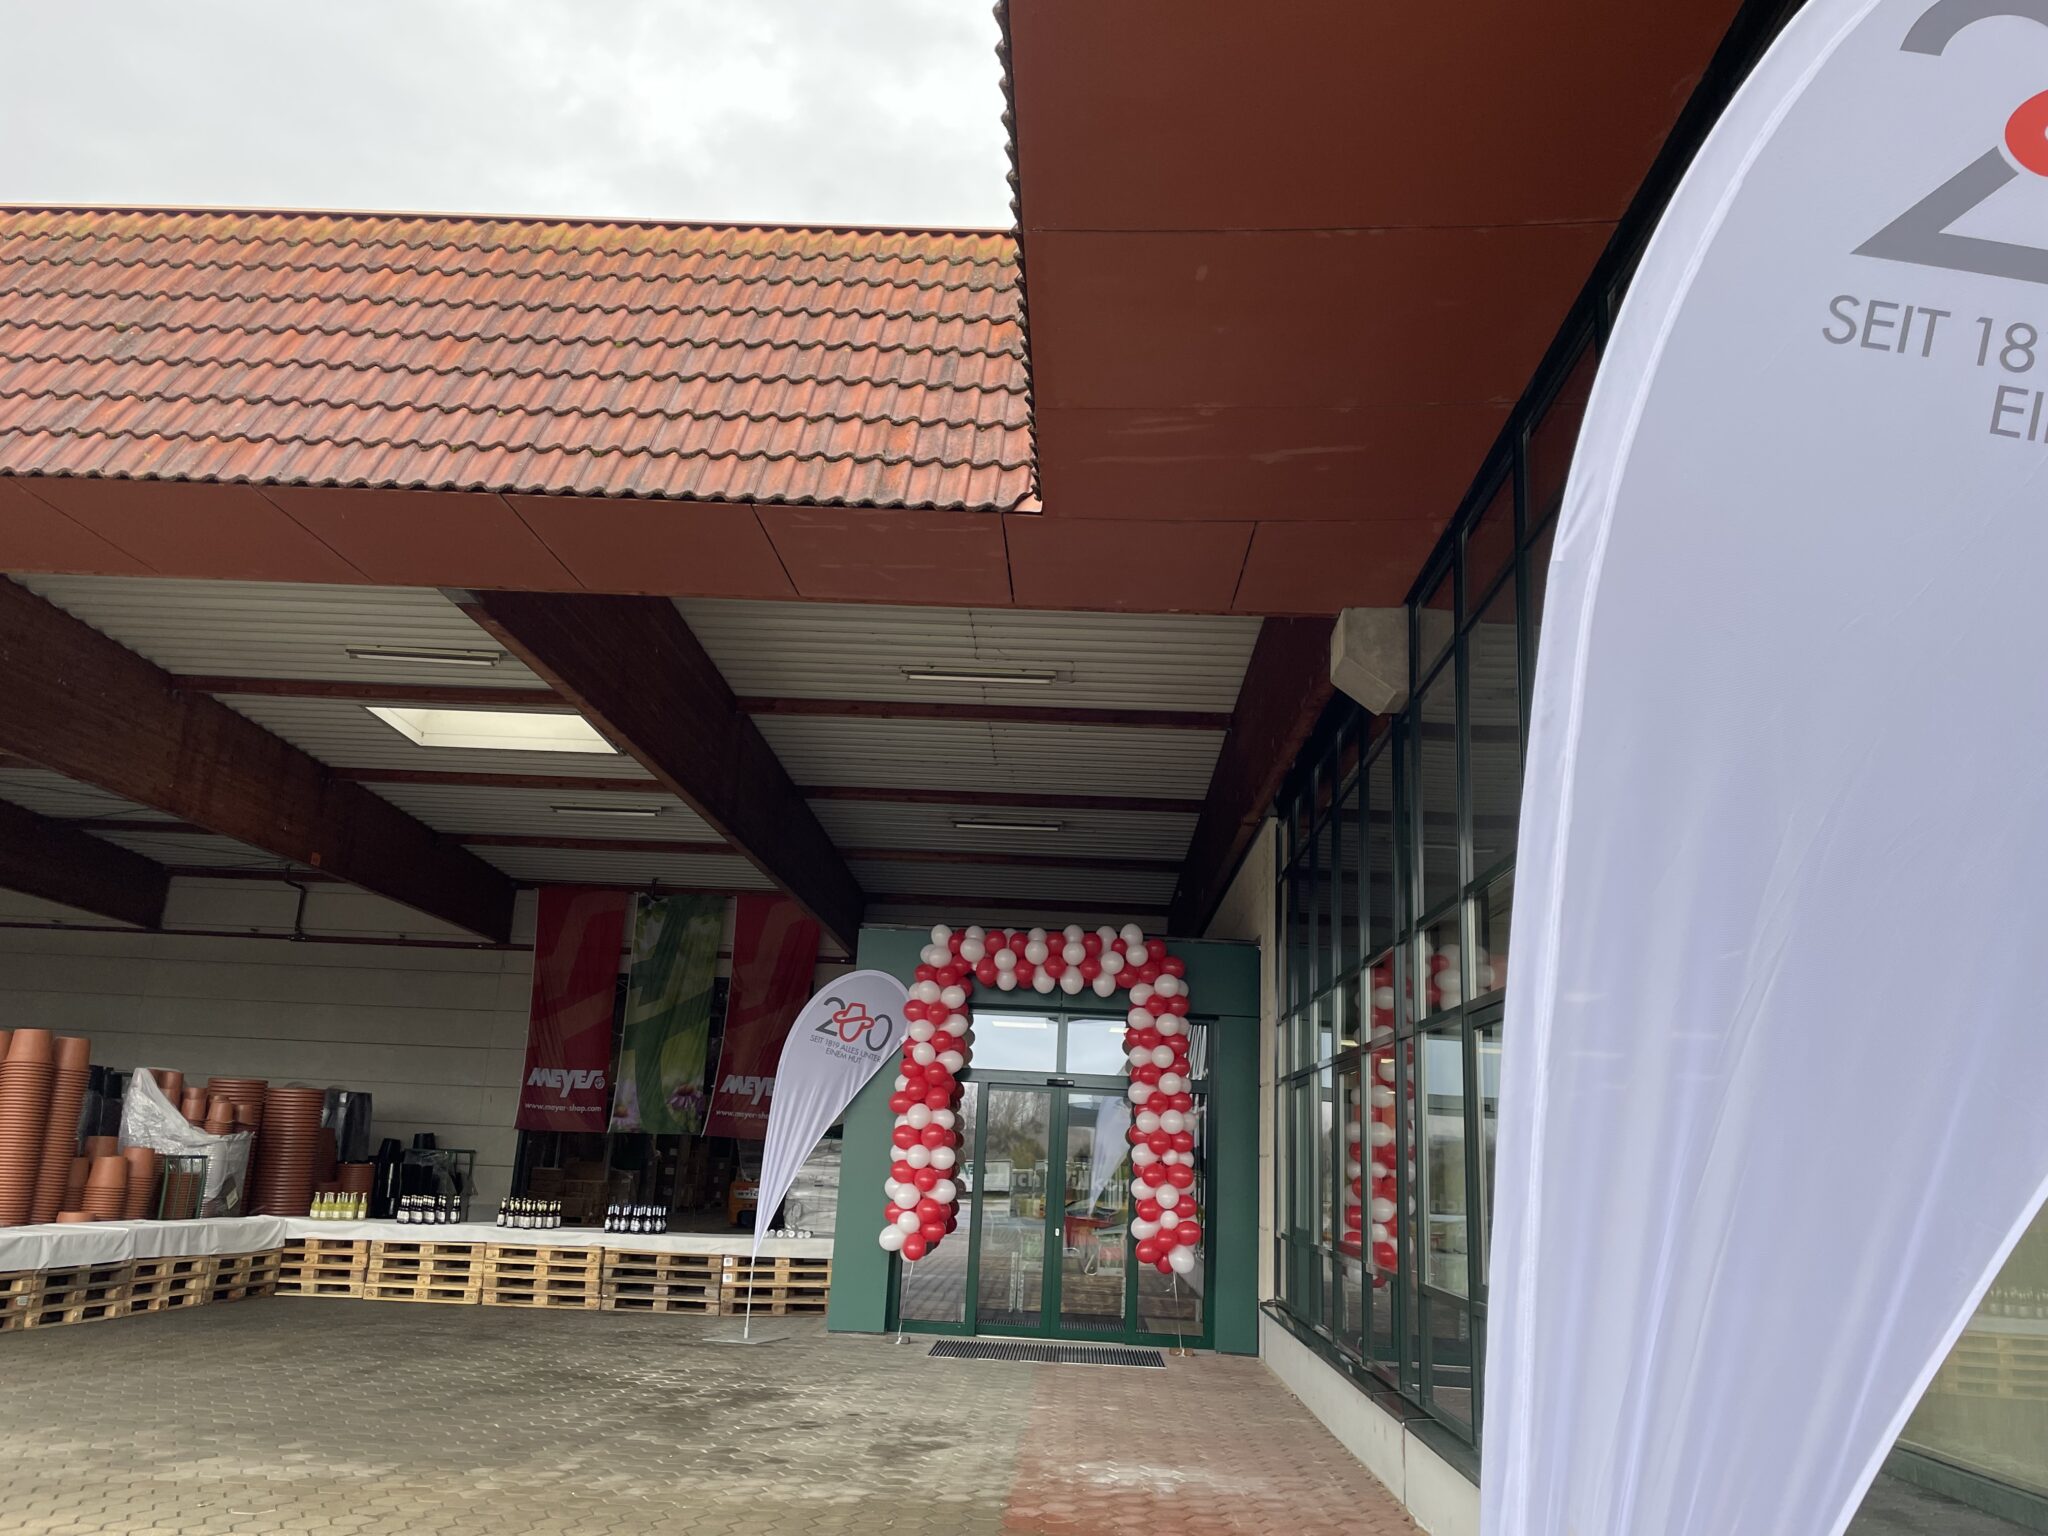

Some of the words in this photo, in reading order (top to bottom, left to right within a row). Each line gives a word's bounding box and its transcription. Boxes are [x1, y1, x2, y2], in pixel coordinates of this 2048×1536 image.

[1822, 294, 1952, 358] SEIT
[1975, 316, 2048, 373] 18
[1989, 384, 2048, 444] EI
[809, 1034, 824, 1044] SEIT
[847, 1054, 863, 1065] HUT
[719, 1074, 775, 1105] MEYE
[525, 1102, 602, 1114] www.meyer-shop.com
